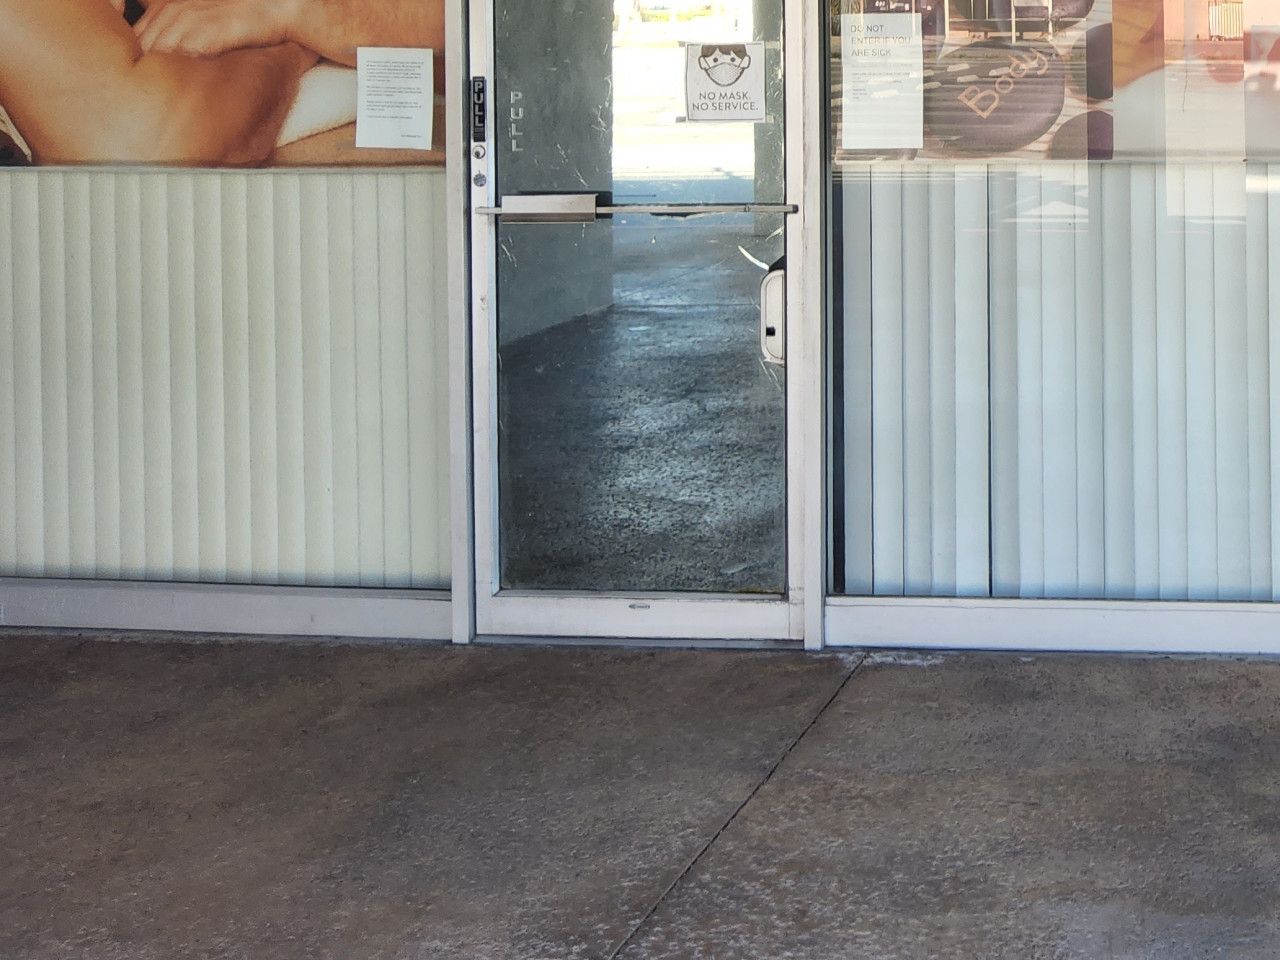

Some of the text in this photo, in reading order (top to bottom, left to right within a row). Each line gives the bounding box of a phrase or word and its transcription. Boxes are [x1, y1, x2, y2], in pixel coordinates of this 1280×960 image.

[866, 24, 884, 33] NOT
[851, 36, 880, 45] ENTER
[892, 36, 911, 45] YOU
[851, 48, 892, 57] ARE SICK
[957, 47, 1049, 119] Body
[699, 91, 716, 101] NO
[474, 81, 484, 127] PULL
[692, 102, 759, 112] NO SERVICE.
[510, 90, 524, 152] PULL
